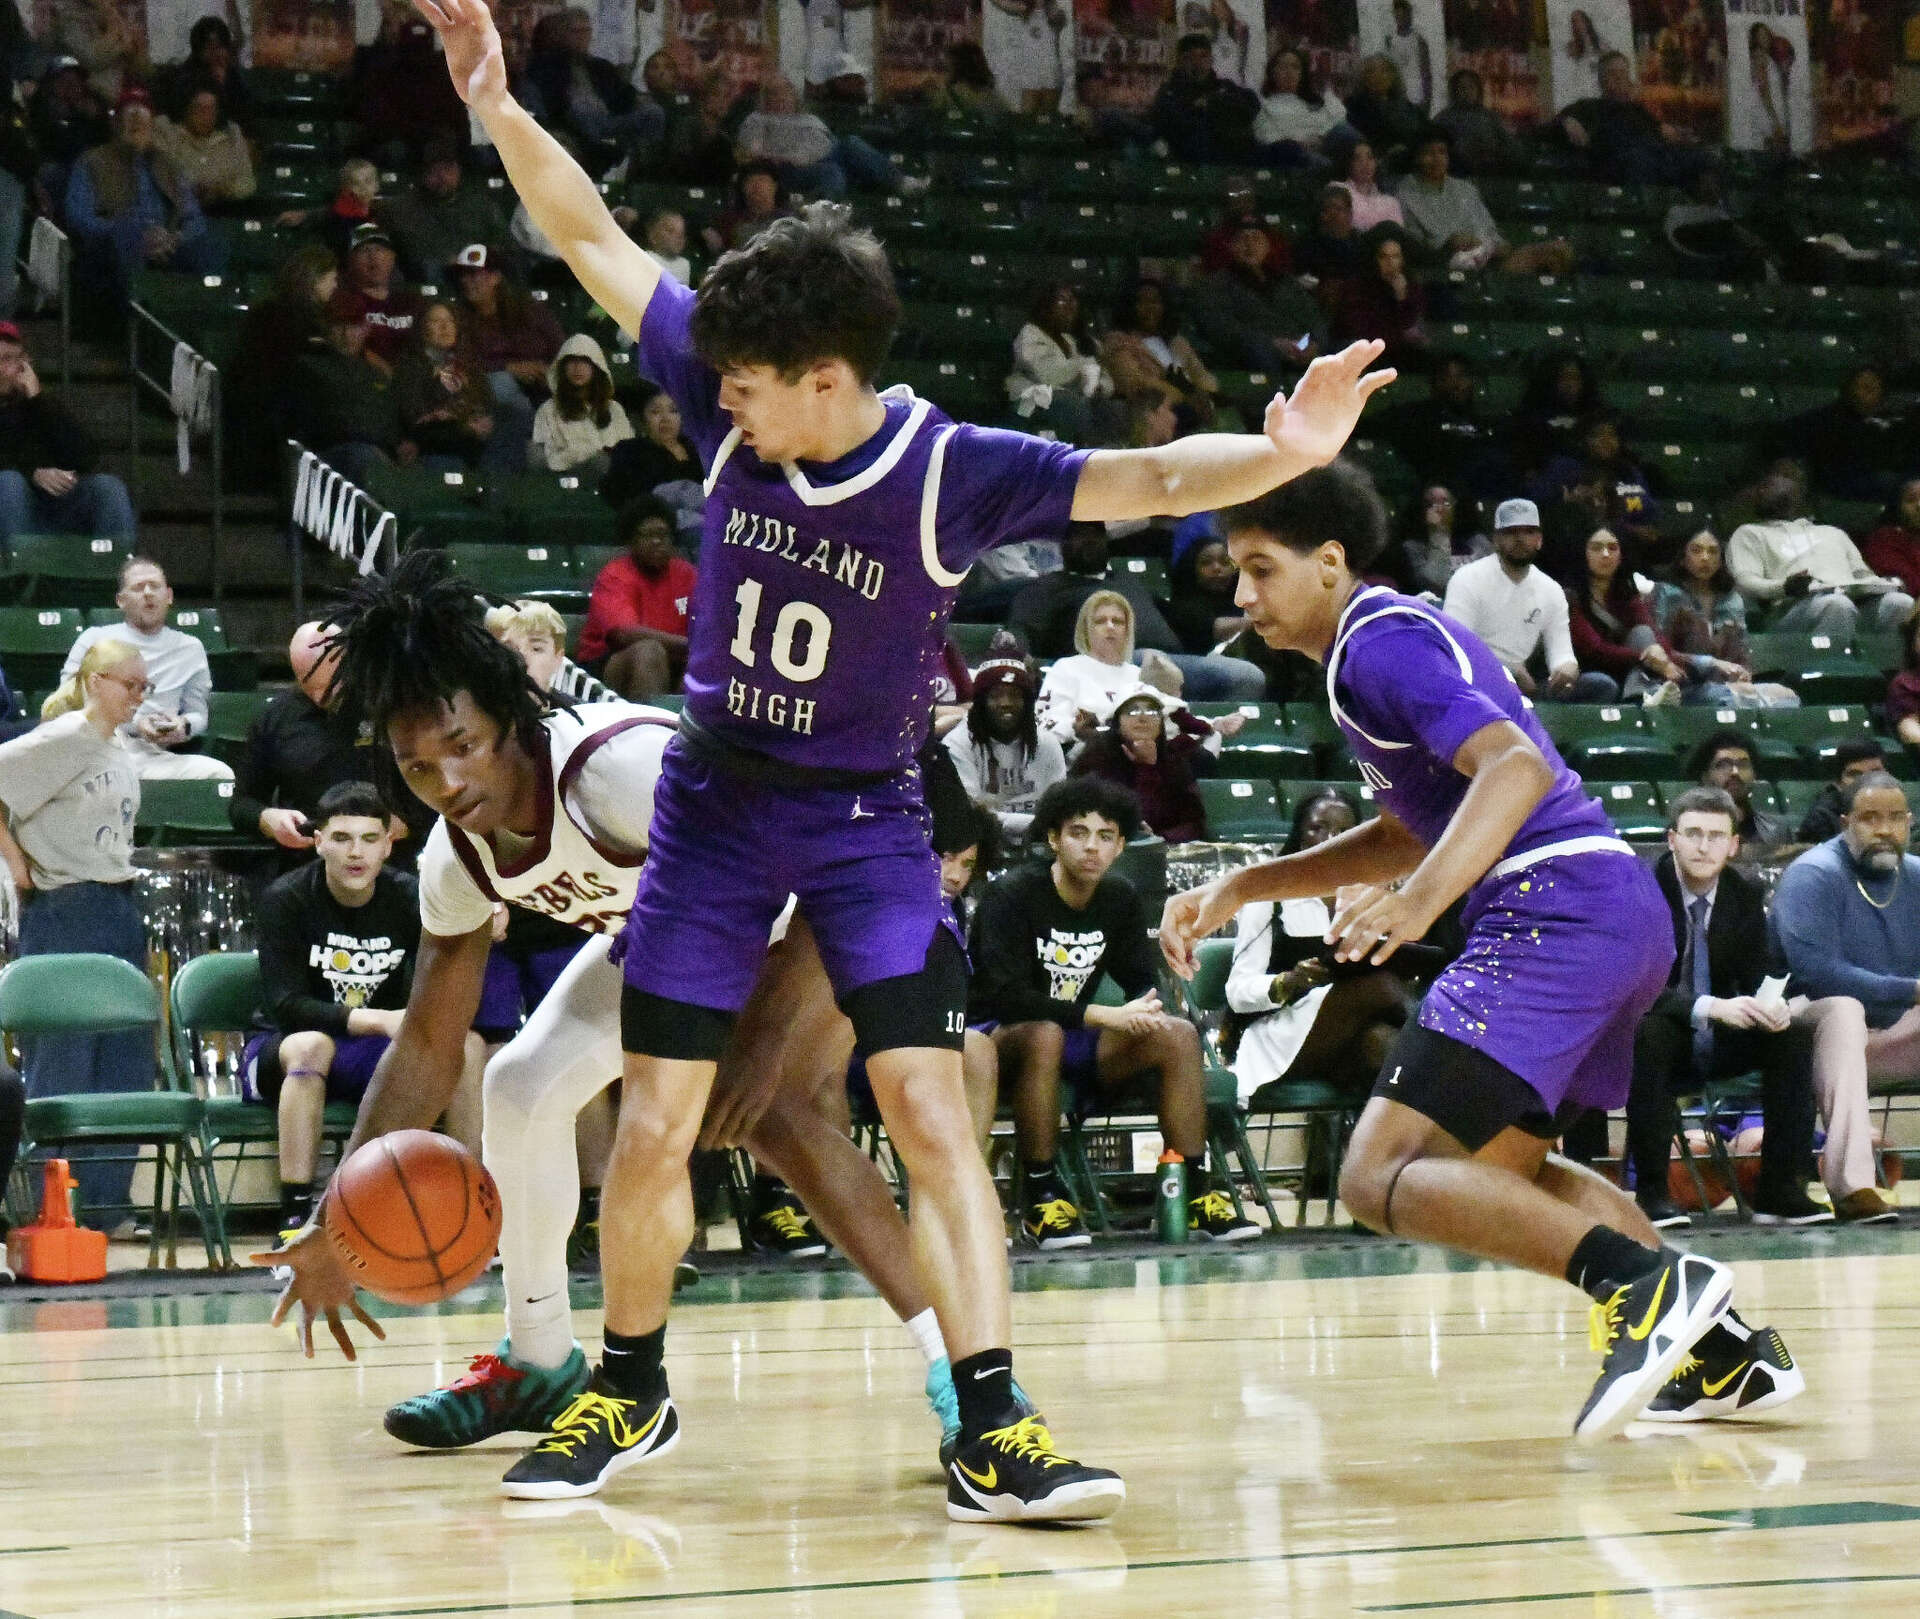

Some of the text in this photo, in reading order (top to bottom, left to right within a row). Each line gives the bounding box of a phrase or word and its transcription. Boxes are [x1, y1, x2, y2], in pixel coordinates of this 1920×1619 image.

[723, 507, 885, 600] MIDLAND
[730, 577, 832, 682] 10
[727, 675, 817, 735] HIGH
[309, 944, 406, 974] HOOPS
[945, 1010, 965, 1034] 10
[1389, 1066, 1402, 1084] 1
[1162, 1178, 1180, 1198] G
